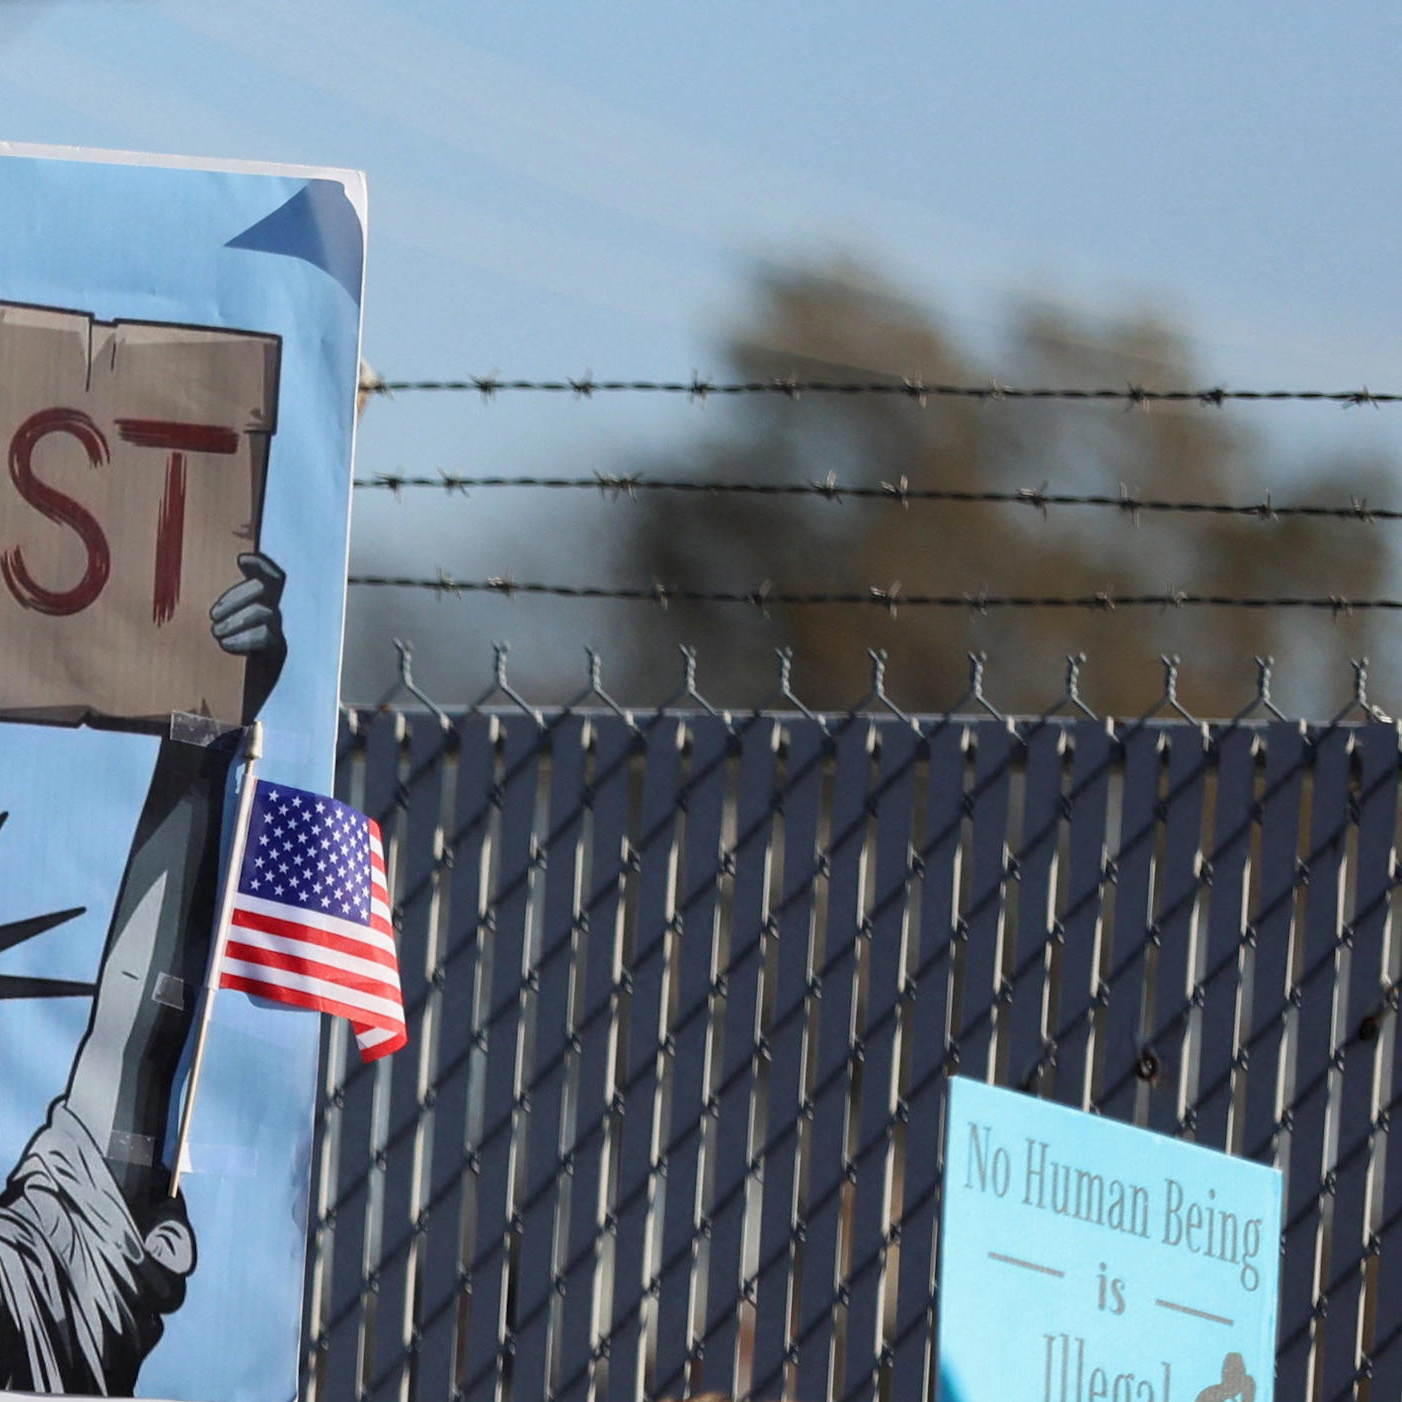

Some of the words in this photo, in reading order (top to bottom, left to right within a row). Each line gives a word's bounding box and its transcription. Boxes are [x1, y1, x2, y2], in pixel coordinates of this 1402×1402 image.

[964, 1121, 1011, 1199] No
[1022, 1138, 1150, 1239] Human
[1162, 1178, 1263, 1292] Being
[1097, 1262, 1126, 1315] is
